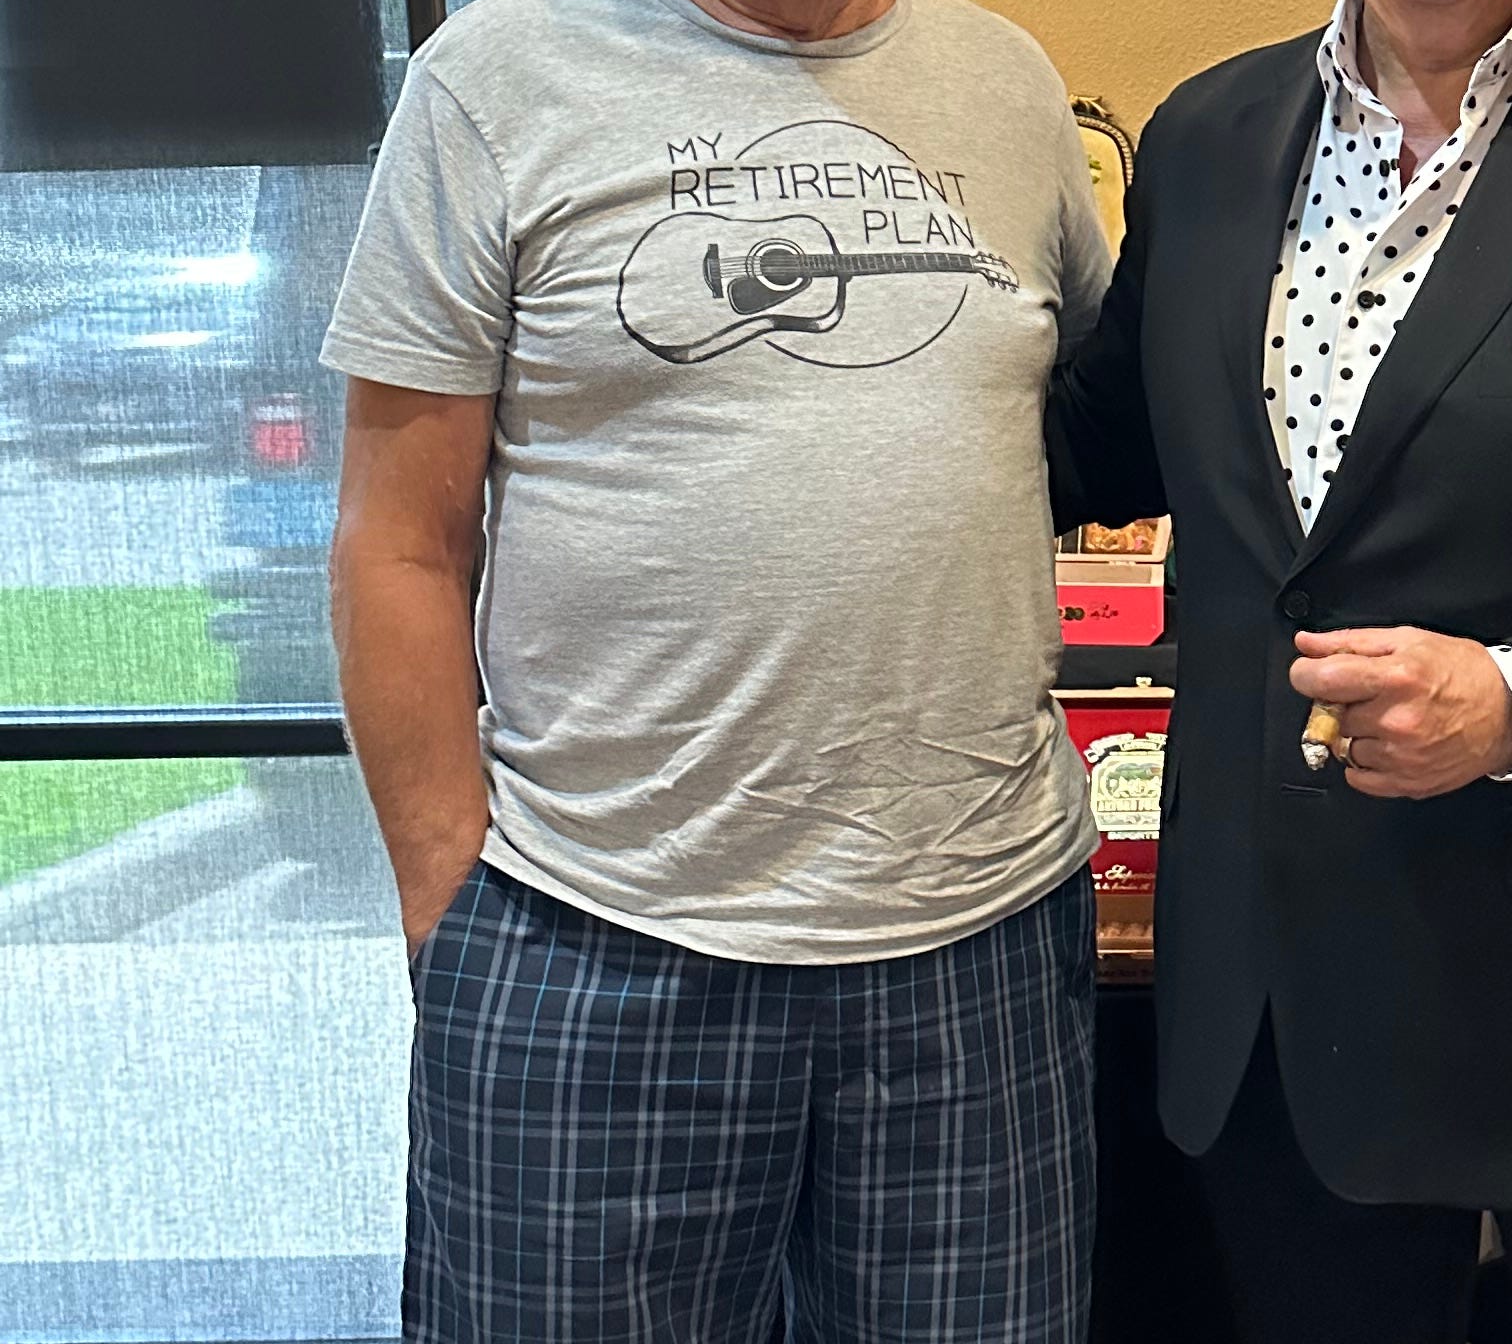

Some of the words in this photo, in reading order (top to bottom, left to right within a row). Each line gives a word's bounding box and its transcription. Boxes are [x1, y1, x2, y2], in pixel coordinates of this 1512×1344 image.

[667, 131, 722, 164] MY
[670, 162, 966, 210] RETIREMENT
[863, 209, 976, 249] PLAN
